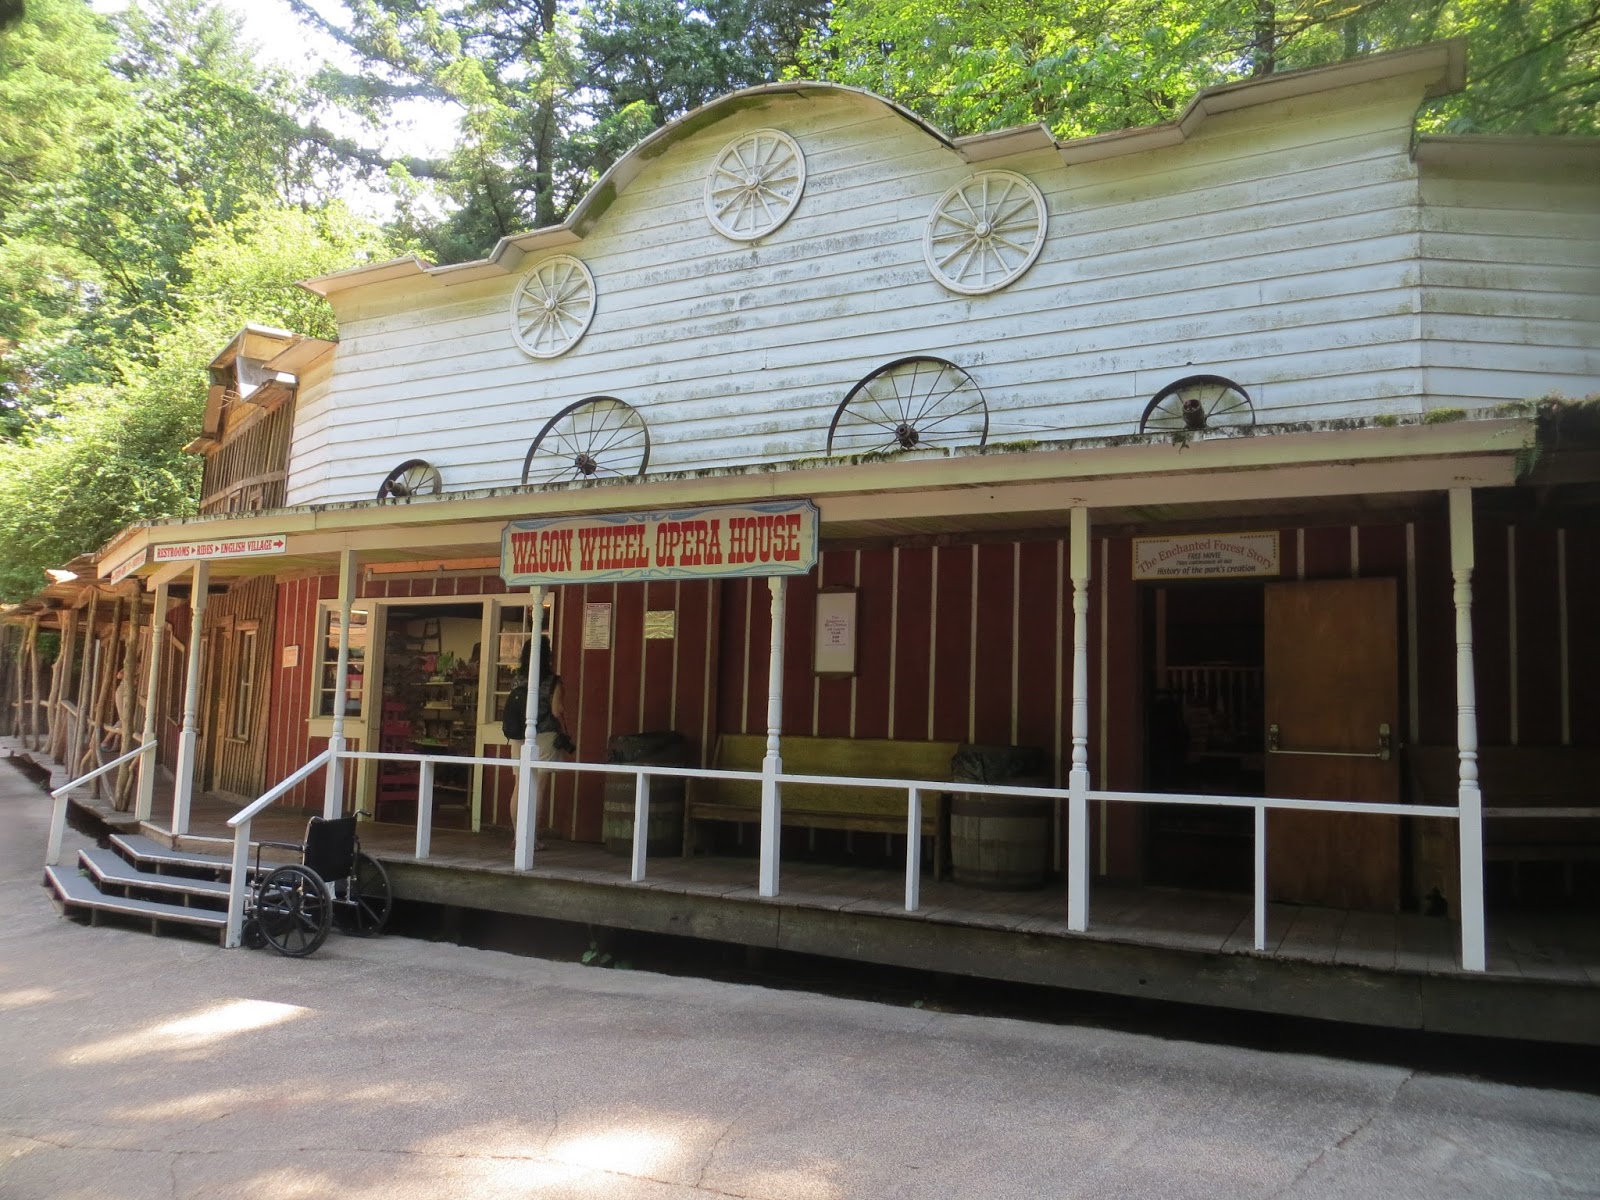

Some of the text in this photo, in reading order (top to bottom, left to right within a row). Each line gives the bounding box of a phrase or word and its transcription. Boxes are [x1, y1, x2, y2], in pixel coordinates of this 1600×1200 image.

[157, 540, 273, 558] RESTROOMS RIDES ENGLISH VILLAGE
[511, 514, 801, 574] WAGON WHEEL OPERA HOUSE
[1138, 539, 1274, 573] The Enchanted Forest Story
[1187, 552, 1202, 560] FREE
[1157, 564, 1256, 575] History of the park's creation
